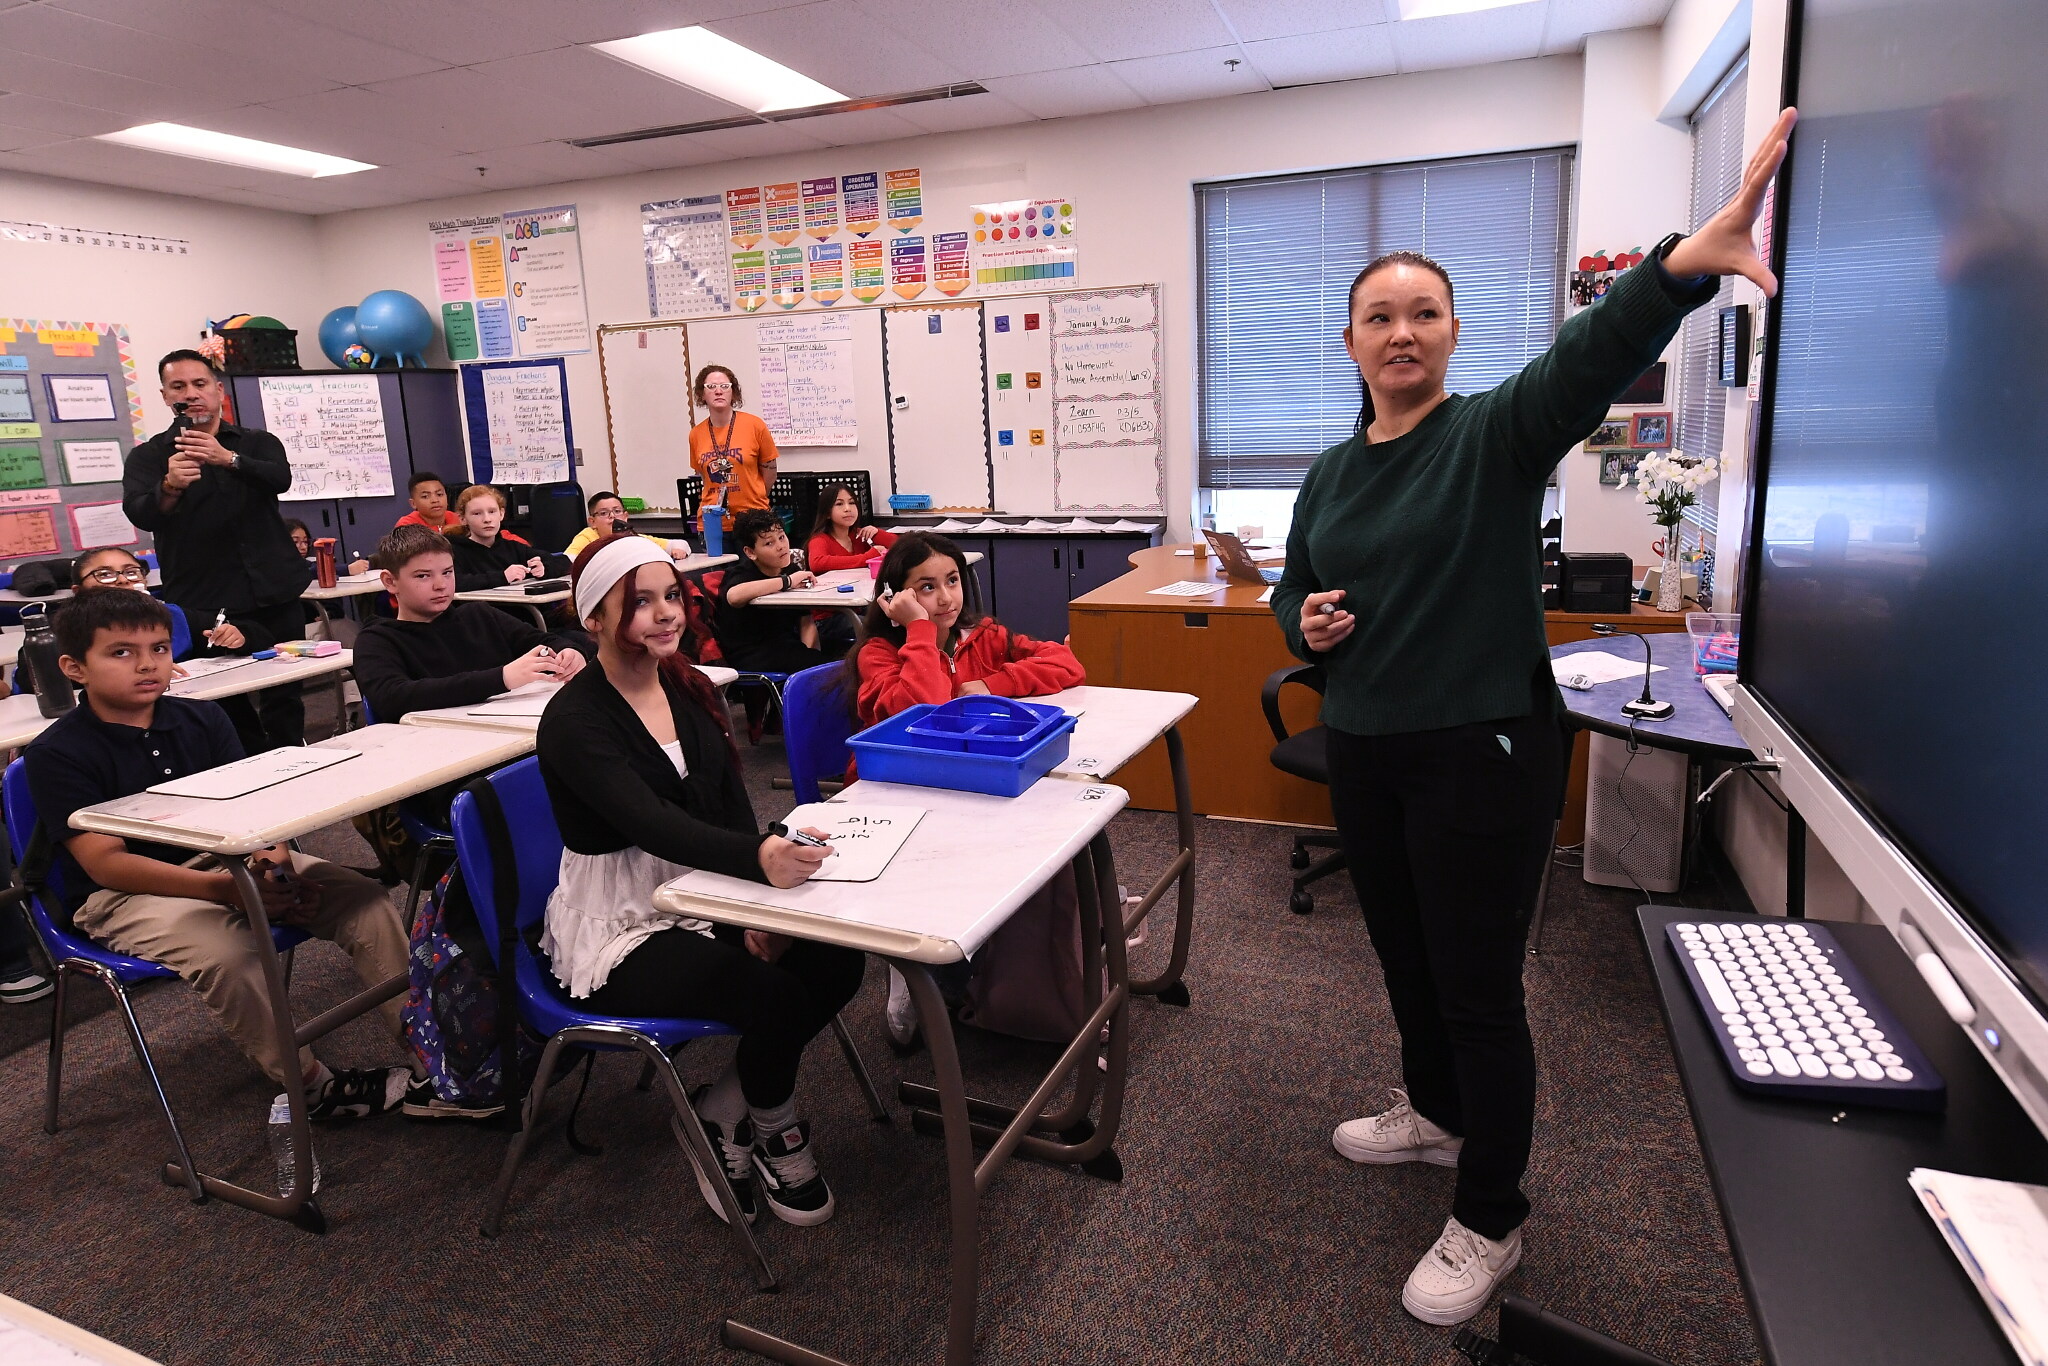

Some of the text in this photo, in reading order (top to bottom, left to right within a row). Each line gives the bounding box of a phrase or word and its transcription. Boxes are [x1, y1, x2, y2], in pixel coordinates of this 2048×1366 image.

[846, 182, 874, 190] OPERATIONS
[515, 221, 540, 240] ACE
[930, 316, 939, 332] 5
[1066, 316, 1131, 329] January 8, 2026
[48, 331, 75, 341] Period
[1065, 360, 1114, 371] No Homework
[486, 371, 547, 383] Dividing Fractions
[1066, 374, 1086, 384] House
[262, 380, 313, 393] Multiplying
[327, 397, 363, 406] Represent
[1070, 405, 1095, 418] Zearn
[1083, 788, 1106, 800] 2B
